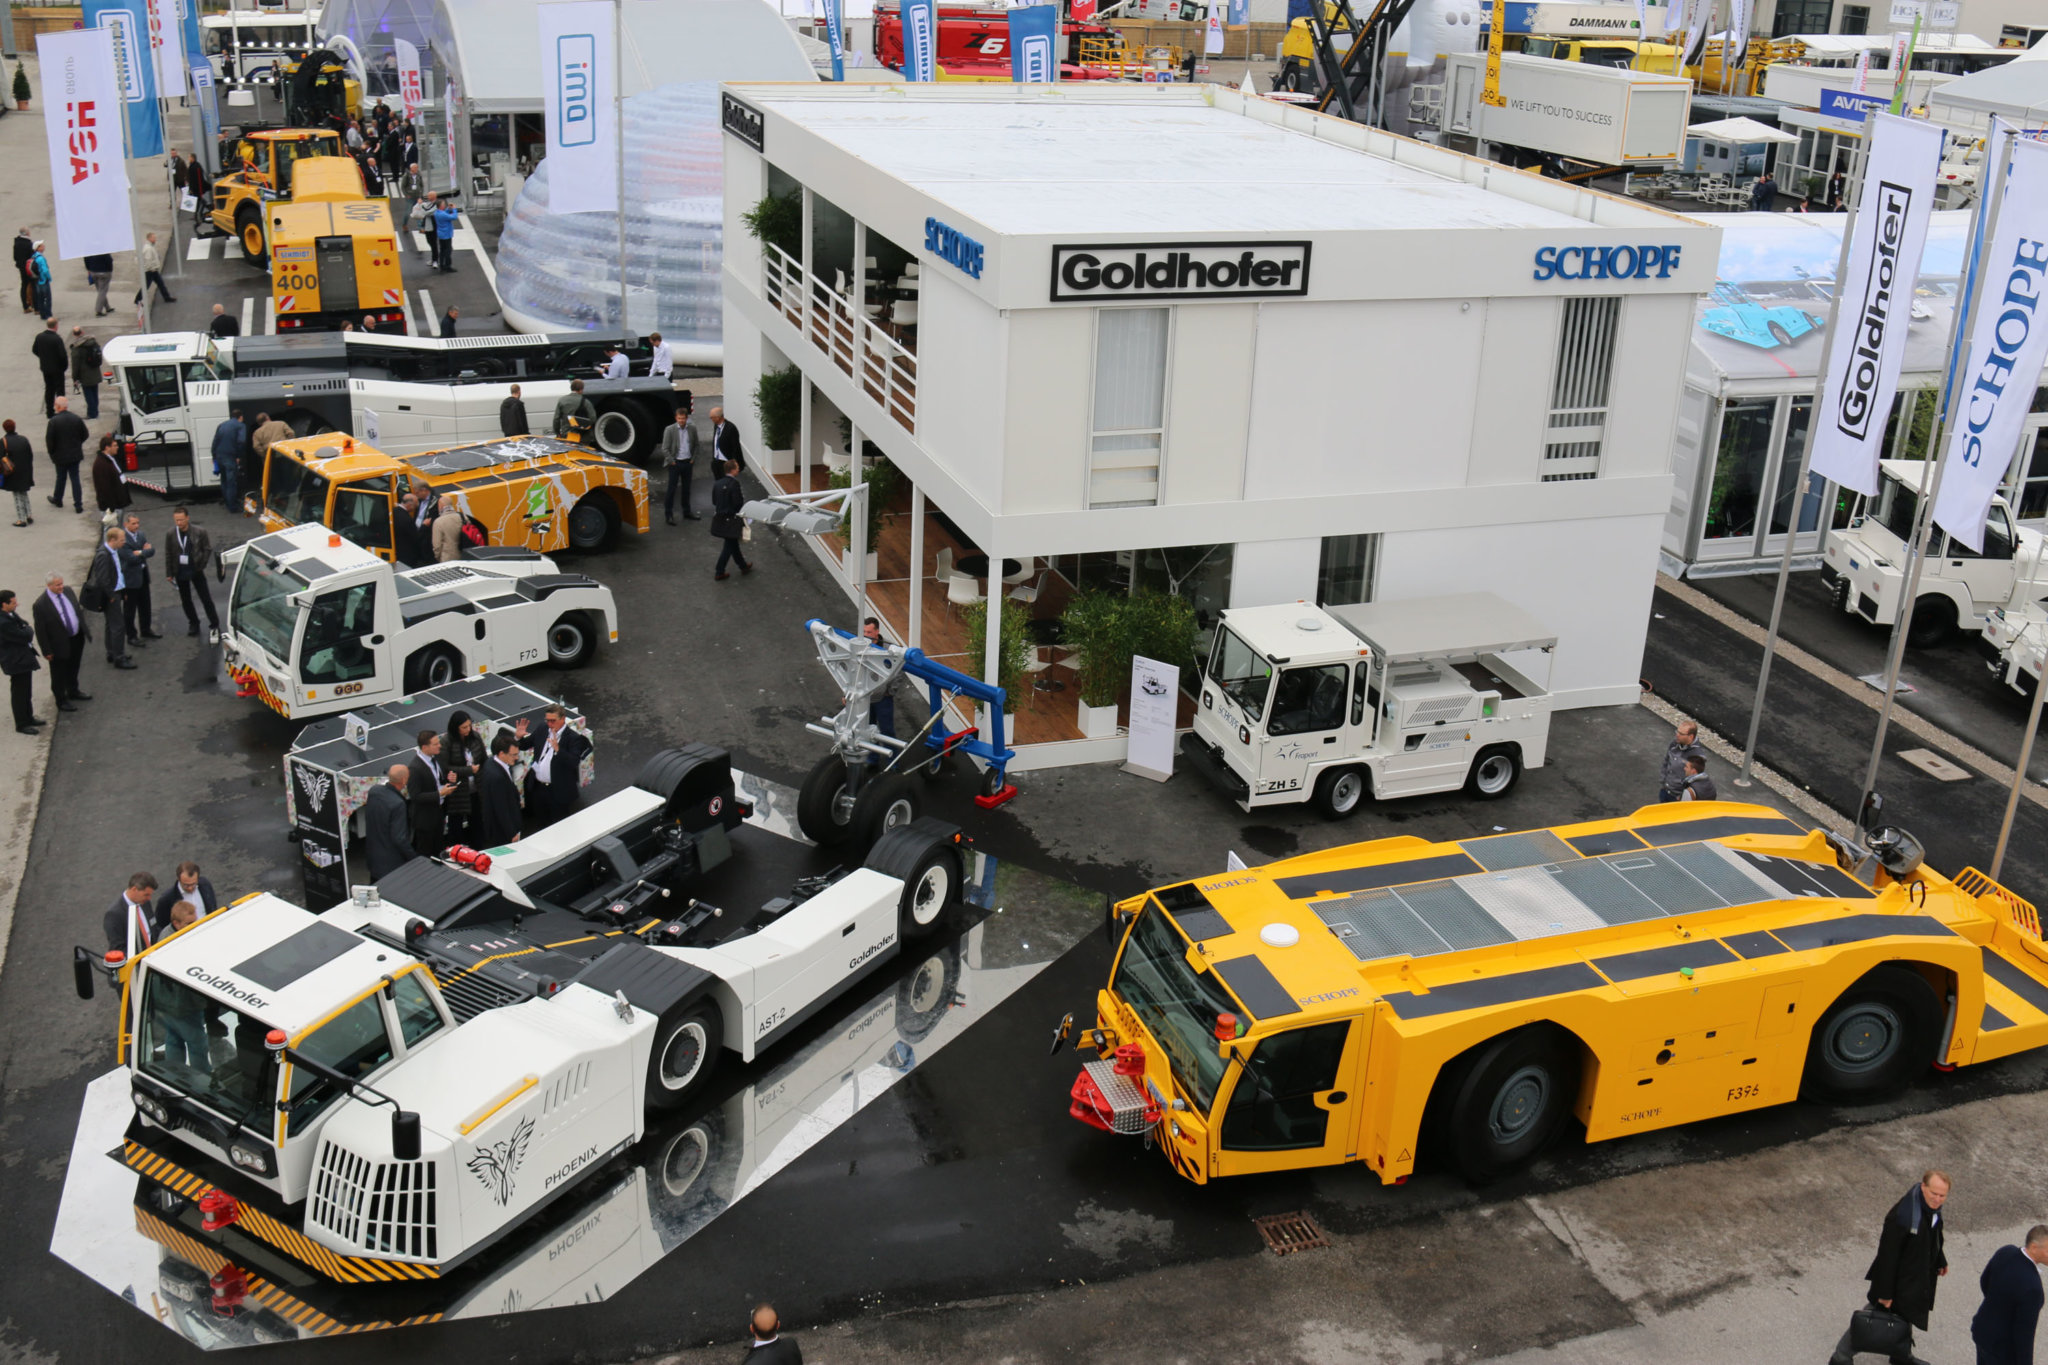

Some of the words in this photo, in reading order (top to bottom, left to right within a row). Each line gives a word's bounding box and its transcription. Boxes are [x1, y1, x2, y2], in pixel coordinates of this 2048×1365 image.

[1569, 18, 1627, 28] DAMMANN
[964, 33, 1007, 54] Z6
[725, 100, 761, 143] Goldhofer
[1511, 99, 1524, 110] WE
[1526, 102, 1541, 113] LIFT
[1543, 105, 1560, 117] YOU
[1562, 107, 1573, 119] TO
[1575, 110, 1612, 126] SUCCESS
[925, 217, 983, 280] SCHOPF
[1062, 251, 1300, 290] Goldhofer
[1534, 244, 1682, 281] SCHOPF
[277, 274, 317, 291] 400
[1843, 194, 1901, 426] Goldhofer
[1962, 237, 2048, 468] SCHOPF
[520, 648, 538, 661] F70
[1218, 706, 1239, 729] SCHOPF
[1294, 751, 1319, 761] Fraport
[1268, 780, 1286, 791] ZH
[1290, 779, 1297, 788] 5
[1202, 876, 1258, 892] SCHOPF
[850, 932, 895, 969] Goldhofer
[186, 966, 269, 1009] Goldhofer
[1299, 987, 1361, 1006] SCHOPF
[759, 1007, 786, 1034] AST-2
[1727, 1084, 1760, 1101] F396
[1620, 1107, 1662, 1123] SCHOPF
[545, 1144, 599, 1189] PHOENIX
